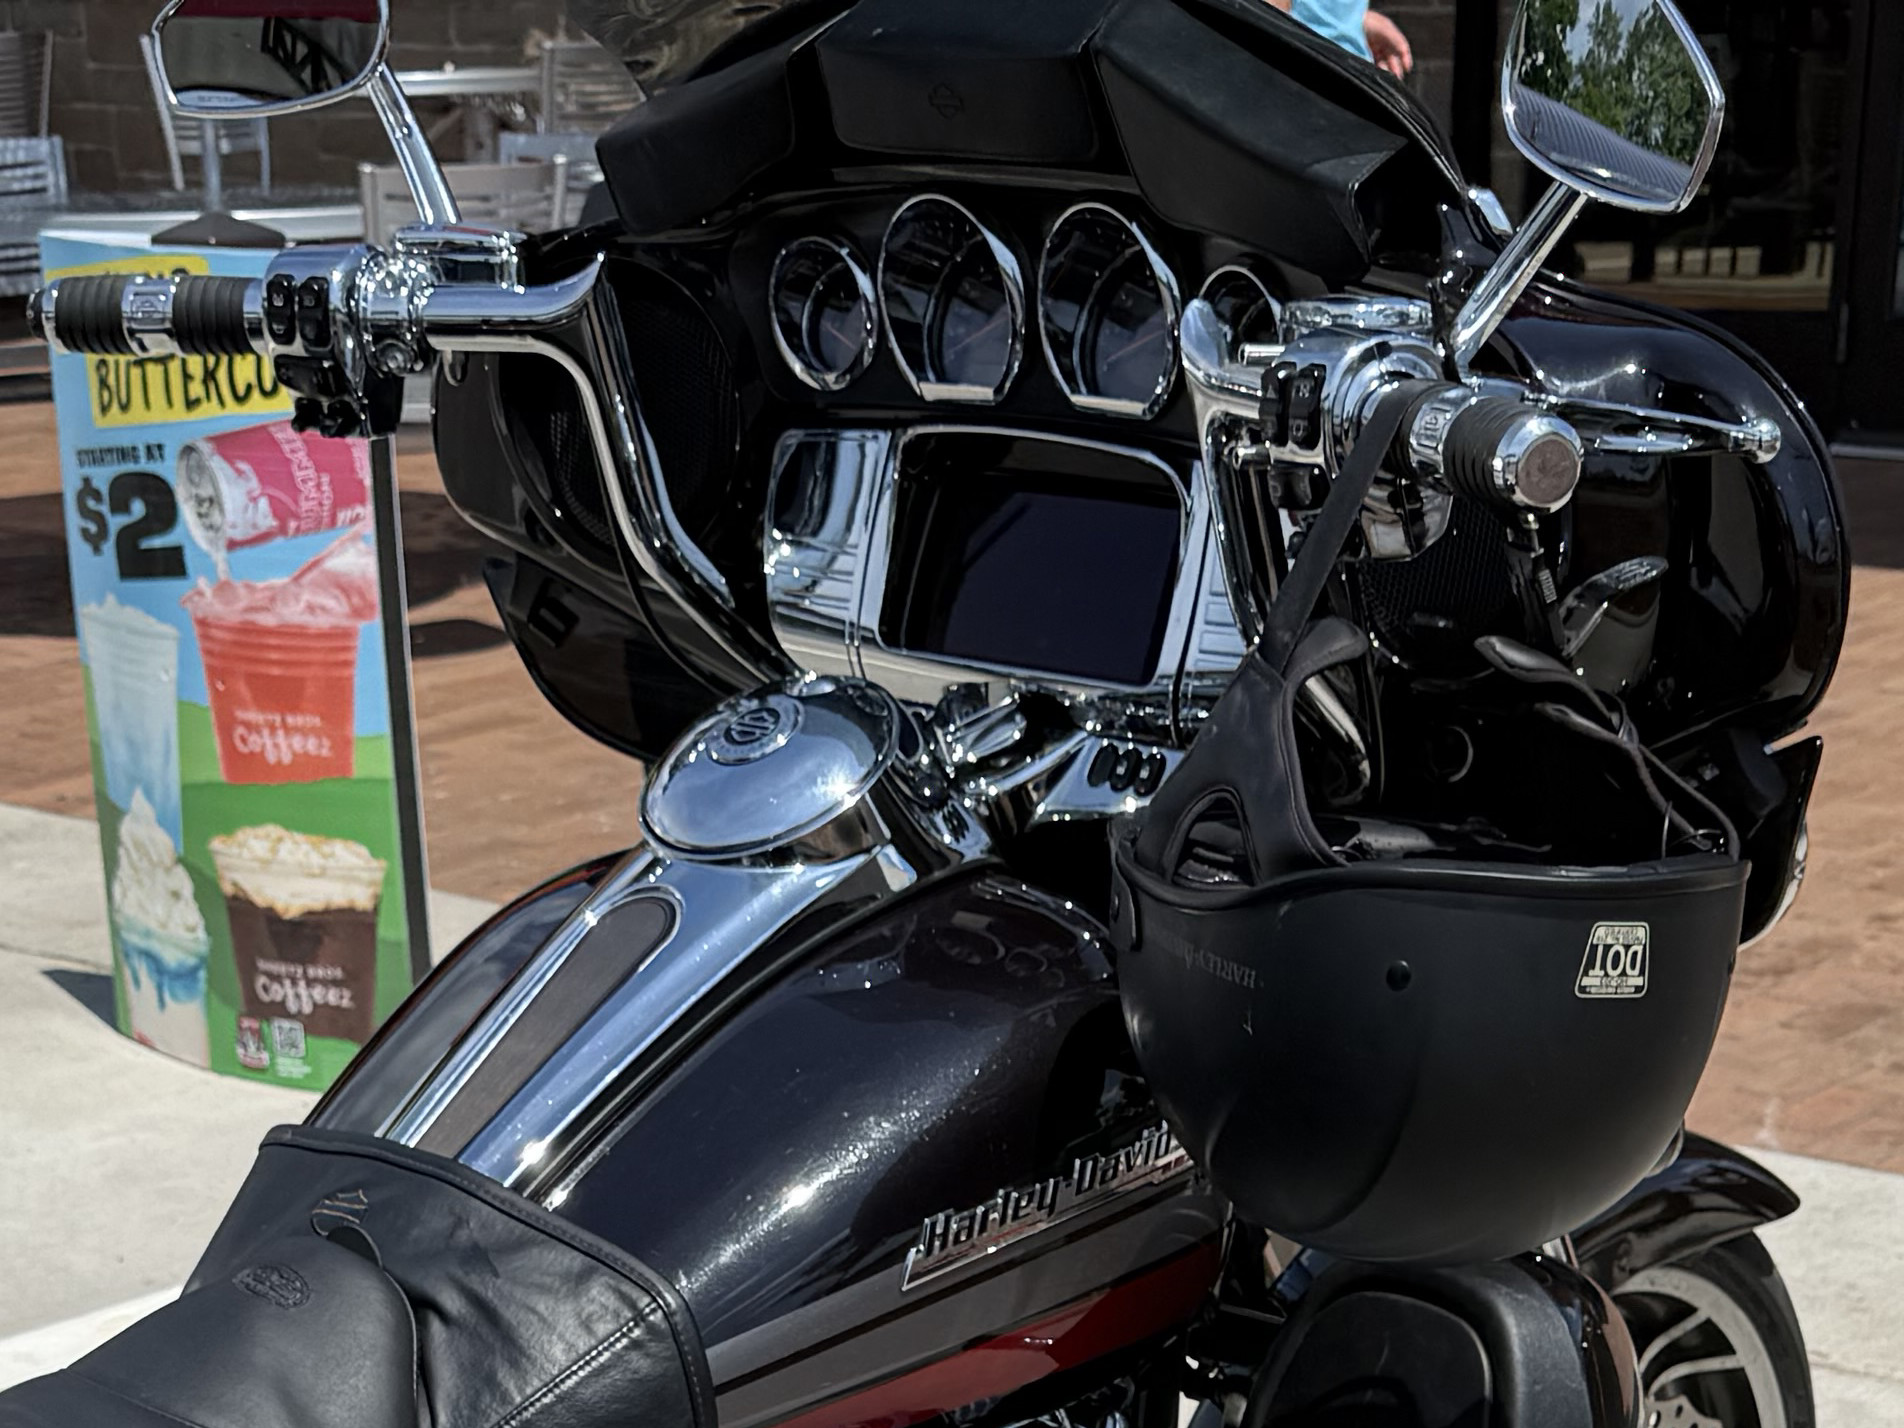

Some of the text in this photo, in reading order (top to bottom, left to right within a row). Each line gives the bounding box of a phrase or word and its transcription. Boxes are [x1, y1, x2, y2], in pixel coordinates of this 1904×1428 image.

[96, 353, 278, 417] BUTTERCU
[75, 443, 166, 467] STARTING AT
[75, 471, 189, 582] $2
[232, 724, 333, 766] Coffeez
[1588, 944, 1643, 977] DOT
[254, 974, 355, 1016] Coffeez
[920, 1118, 1174, 1262] Harley-David
